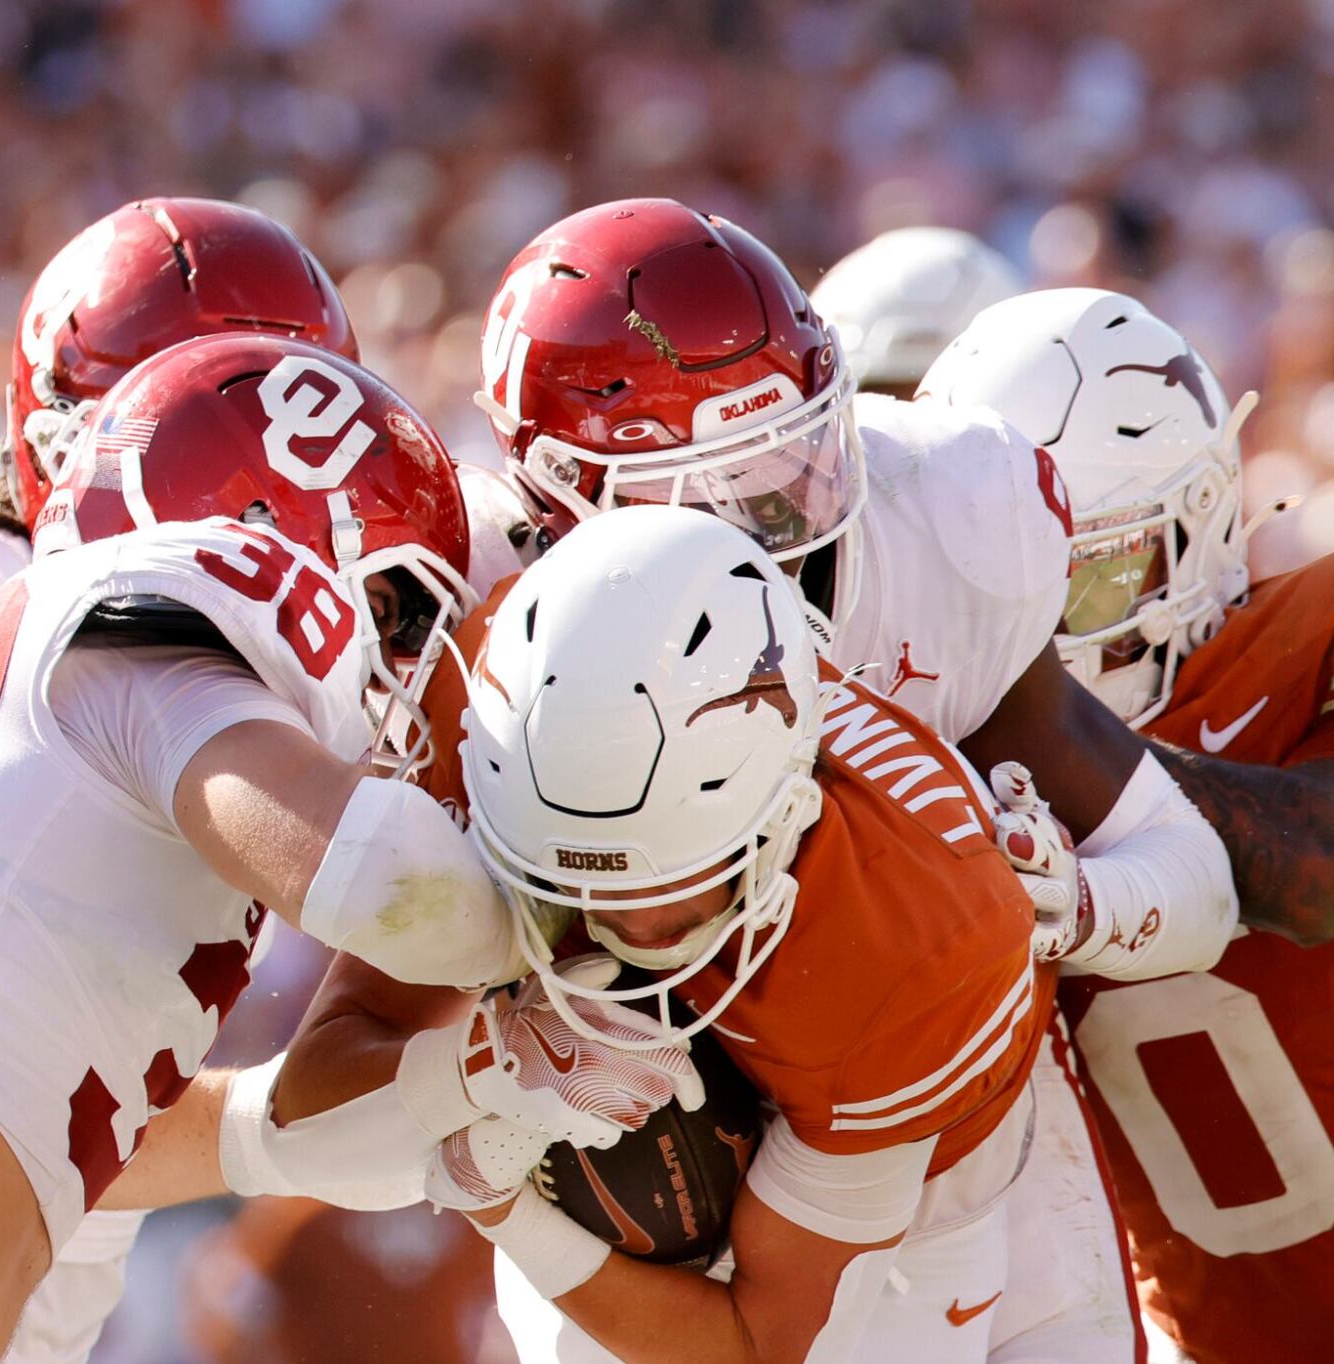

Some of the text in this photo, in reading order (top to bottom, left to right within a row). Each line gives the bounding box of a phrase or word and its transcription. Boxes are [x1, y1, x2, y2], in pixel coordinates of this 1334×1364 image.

[720, 388, 782, 421] OKLAHOMA
[192, 523, 355, 682] 38
[555, 848, 629, 872] HORNS
